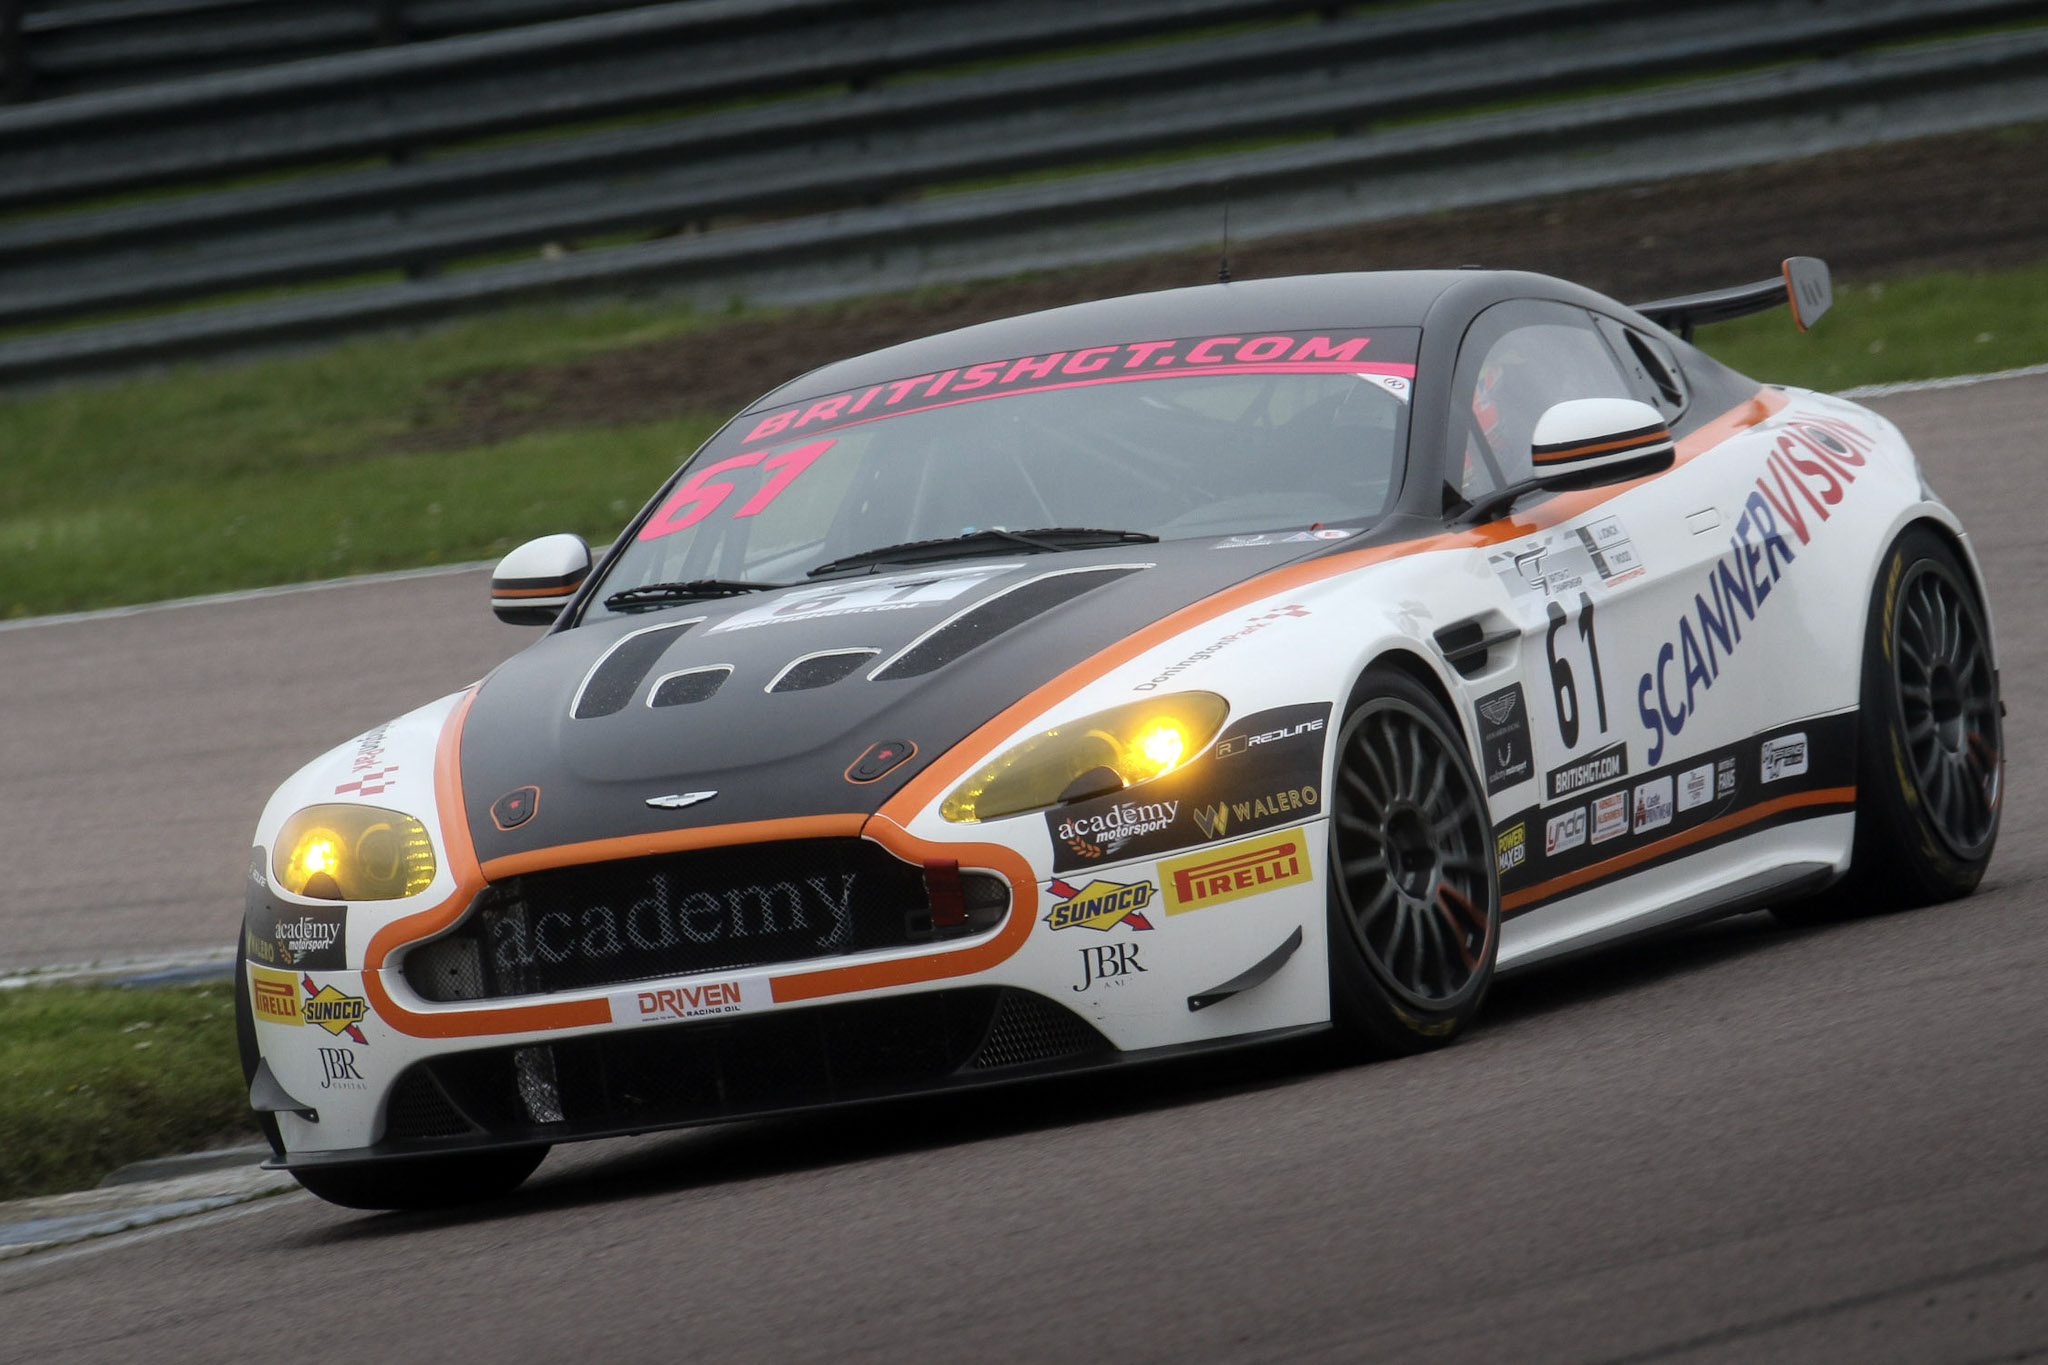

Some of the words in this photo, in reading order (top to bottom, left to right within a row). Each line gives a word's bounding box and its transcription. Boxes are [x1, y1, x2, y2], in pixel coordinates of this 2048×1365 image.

[742, 335, 1371, 445] BRITISHGT.COM
[638, 438, 838, 541] 61
[1638, 412, 1876, 767] SCANNERVISION
[1547, 591, 1608, 749] 61
[1248, 718, 1324, 747] REDLINE
[1556, 754, 1620, 794] BRITISHGT.COM
[1058, 800, 1179, 840] academy
[1232, 785, 1318, 822] WALERO
[1096, 818, 1167, 843] motorsport
[1498, 827, 1524, 850] POWER
[1173, 842, 1300, 904] PIRELLI
[1499, 843, 1525, 870] MAXED
[494, 873, 856, 969] academy
[1054, 884, 1148, 926] SUNOCO
[275, 916, 341, 944] academy
[289, 937, 331, 952] motorsport
[1073, 942, 1149, 992] JBR
[253, 979, 297, 1017] PIRELLI
[307, 1000, 361, 1020] SUNOCO
[637, 981, 742, 1017] DRIVEN
[686, 1007, 721, 1017] RACING
[318, 1047, 365, 1089] JBR
